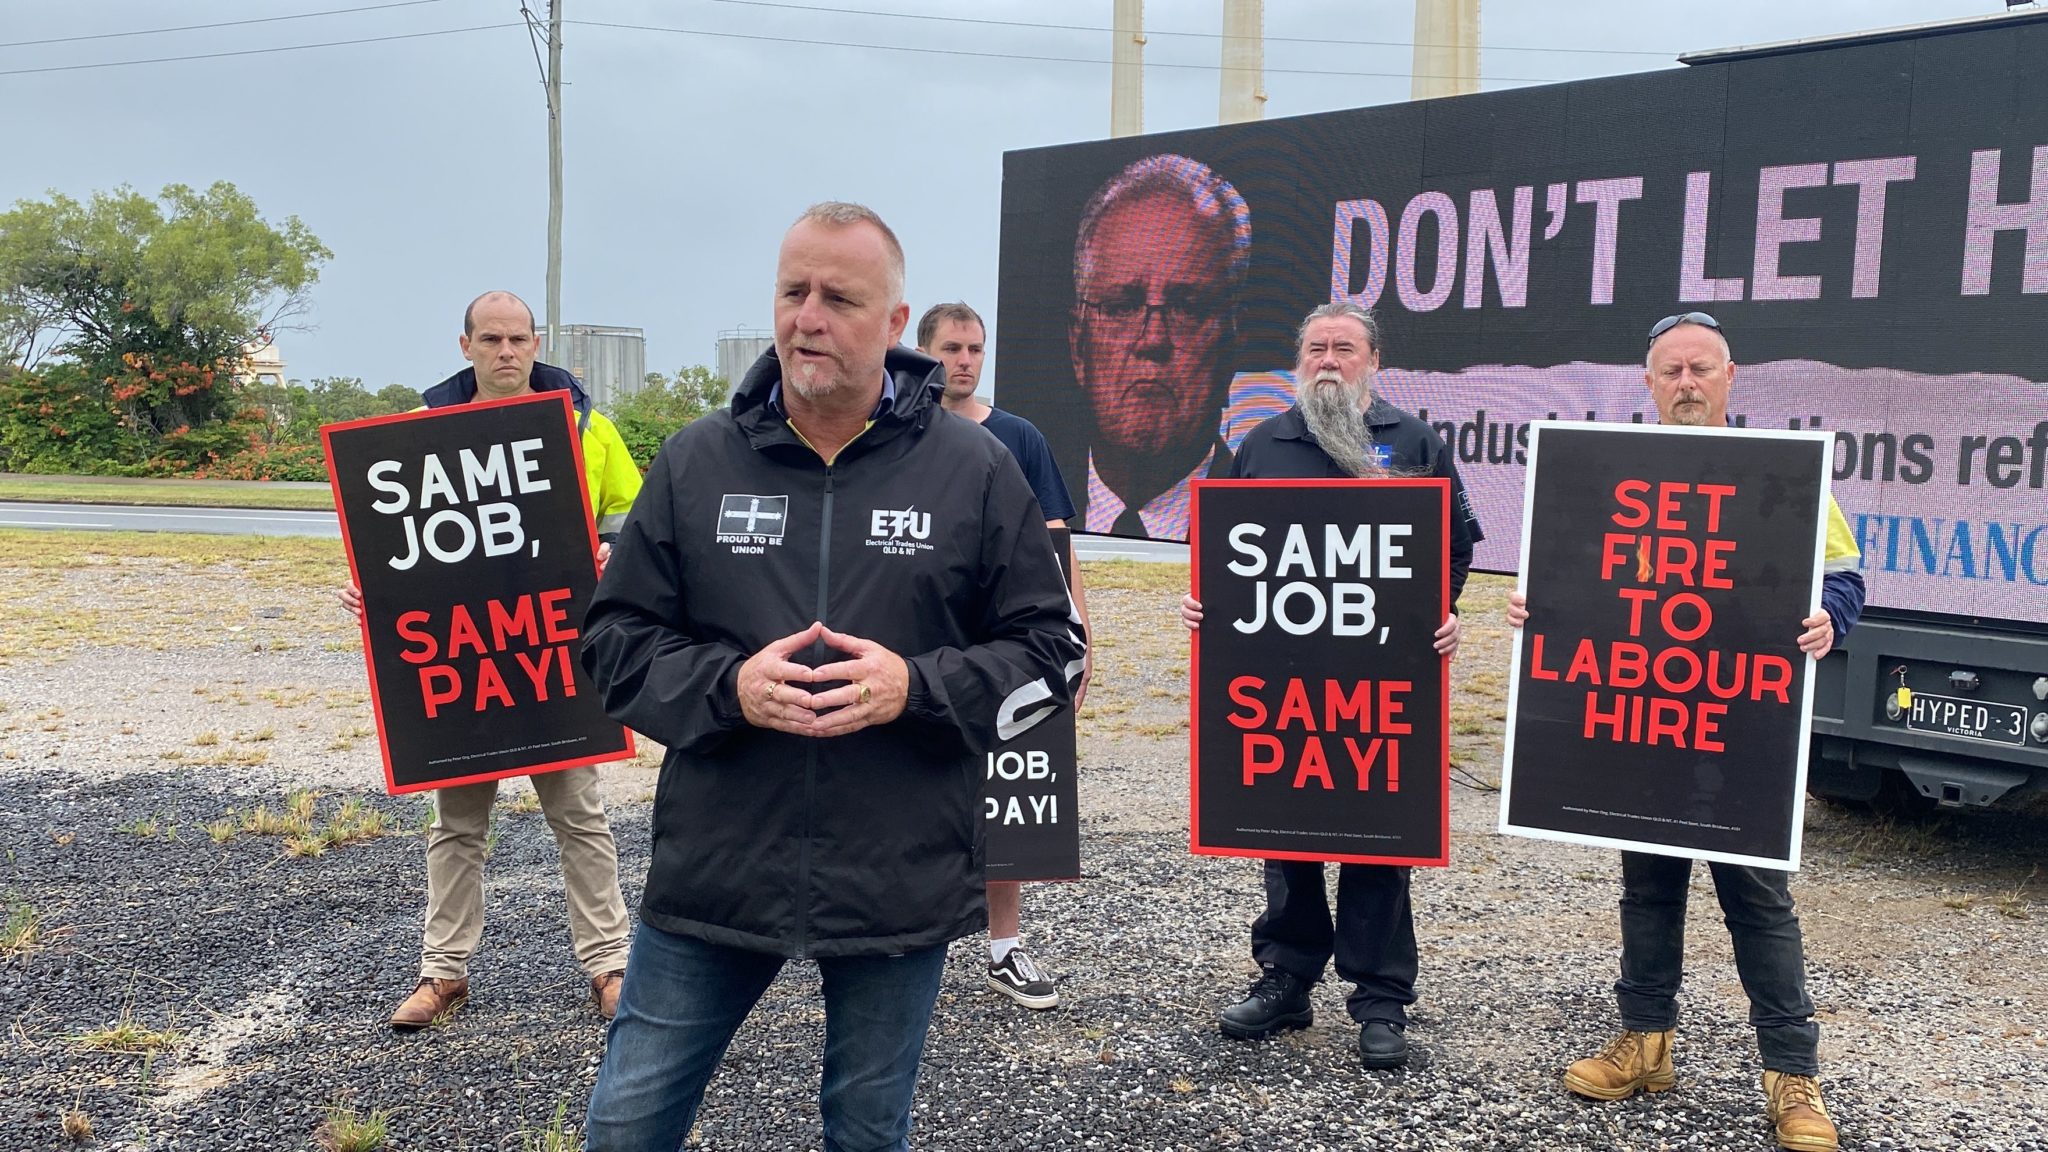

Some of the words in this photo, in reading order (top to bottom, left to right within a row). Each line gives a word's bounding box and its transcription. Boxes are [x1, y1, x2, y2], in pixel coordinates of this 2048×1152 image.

[1331, 176, 1644, 312] DON'T
[1679, 156, 1917, 302] LET
[367, 438, 552, 514] SAME
[871, 505, 931, 539] ETU
[1611, 480, 1736, 533] SET
[388, 502, 540, 570] JOB,
[716, 535, 750, 543] PROUD
[753, 536, 766, 544] TO
[769, 537, 783, 546] BE
[732, 546, 764, 554] UNION
[883, 546, 897, 554] QLD
[898, 547, 905, 555] &
[895, 540, 915, 548] Trades
[916, 542, 934, 550] Union
[1227, 523, 1412, 579] SAME
[1601, 533, 1736, 589] FIRE
[396, 588, 579, 664] SAME
[1232, 581, 1390, 644] JOB,
[1618, 588, 1713, 641] TO
[418, 647, 576, 719] PAY!
[1531, 634, 1793, 703] LABOUR
[1227, 675, 1412, 735] SAME
[1583, 691, 1728, 753] HIRE
[1947, 726, 1983, 737] VICTORIA
[1242, 733, 1399, 792] PAY!
